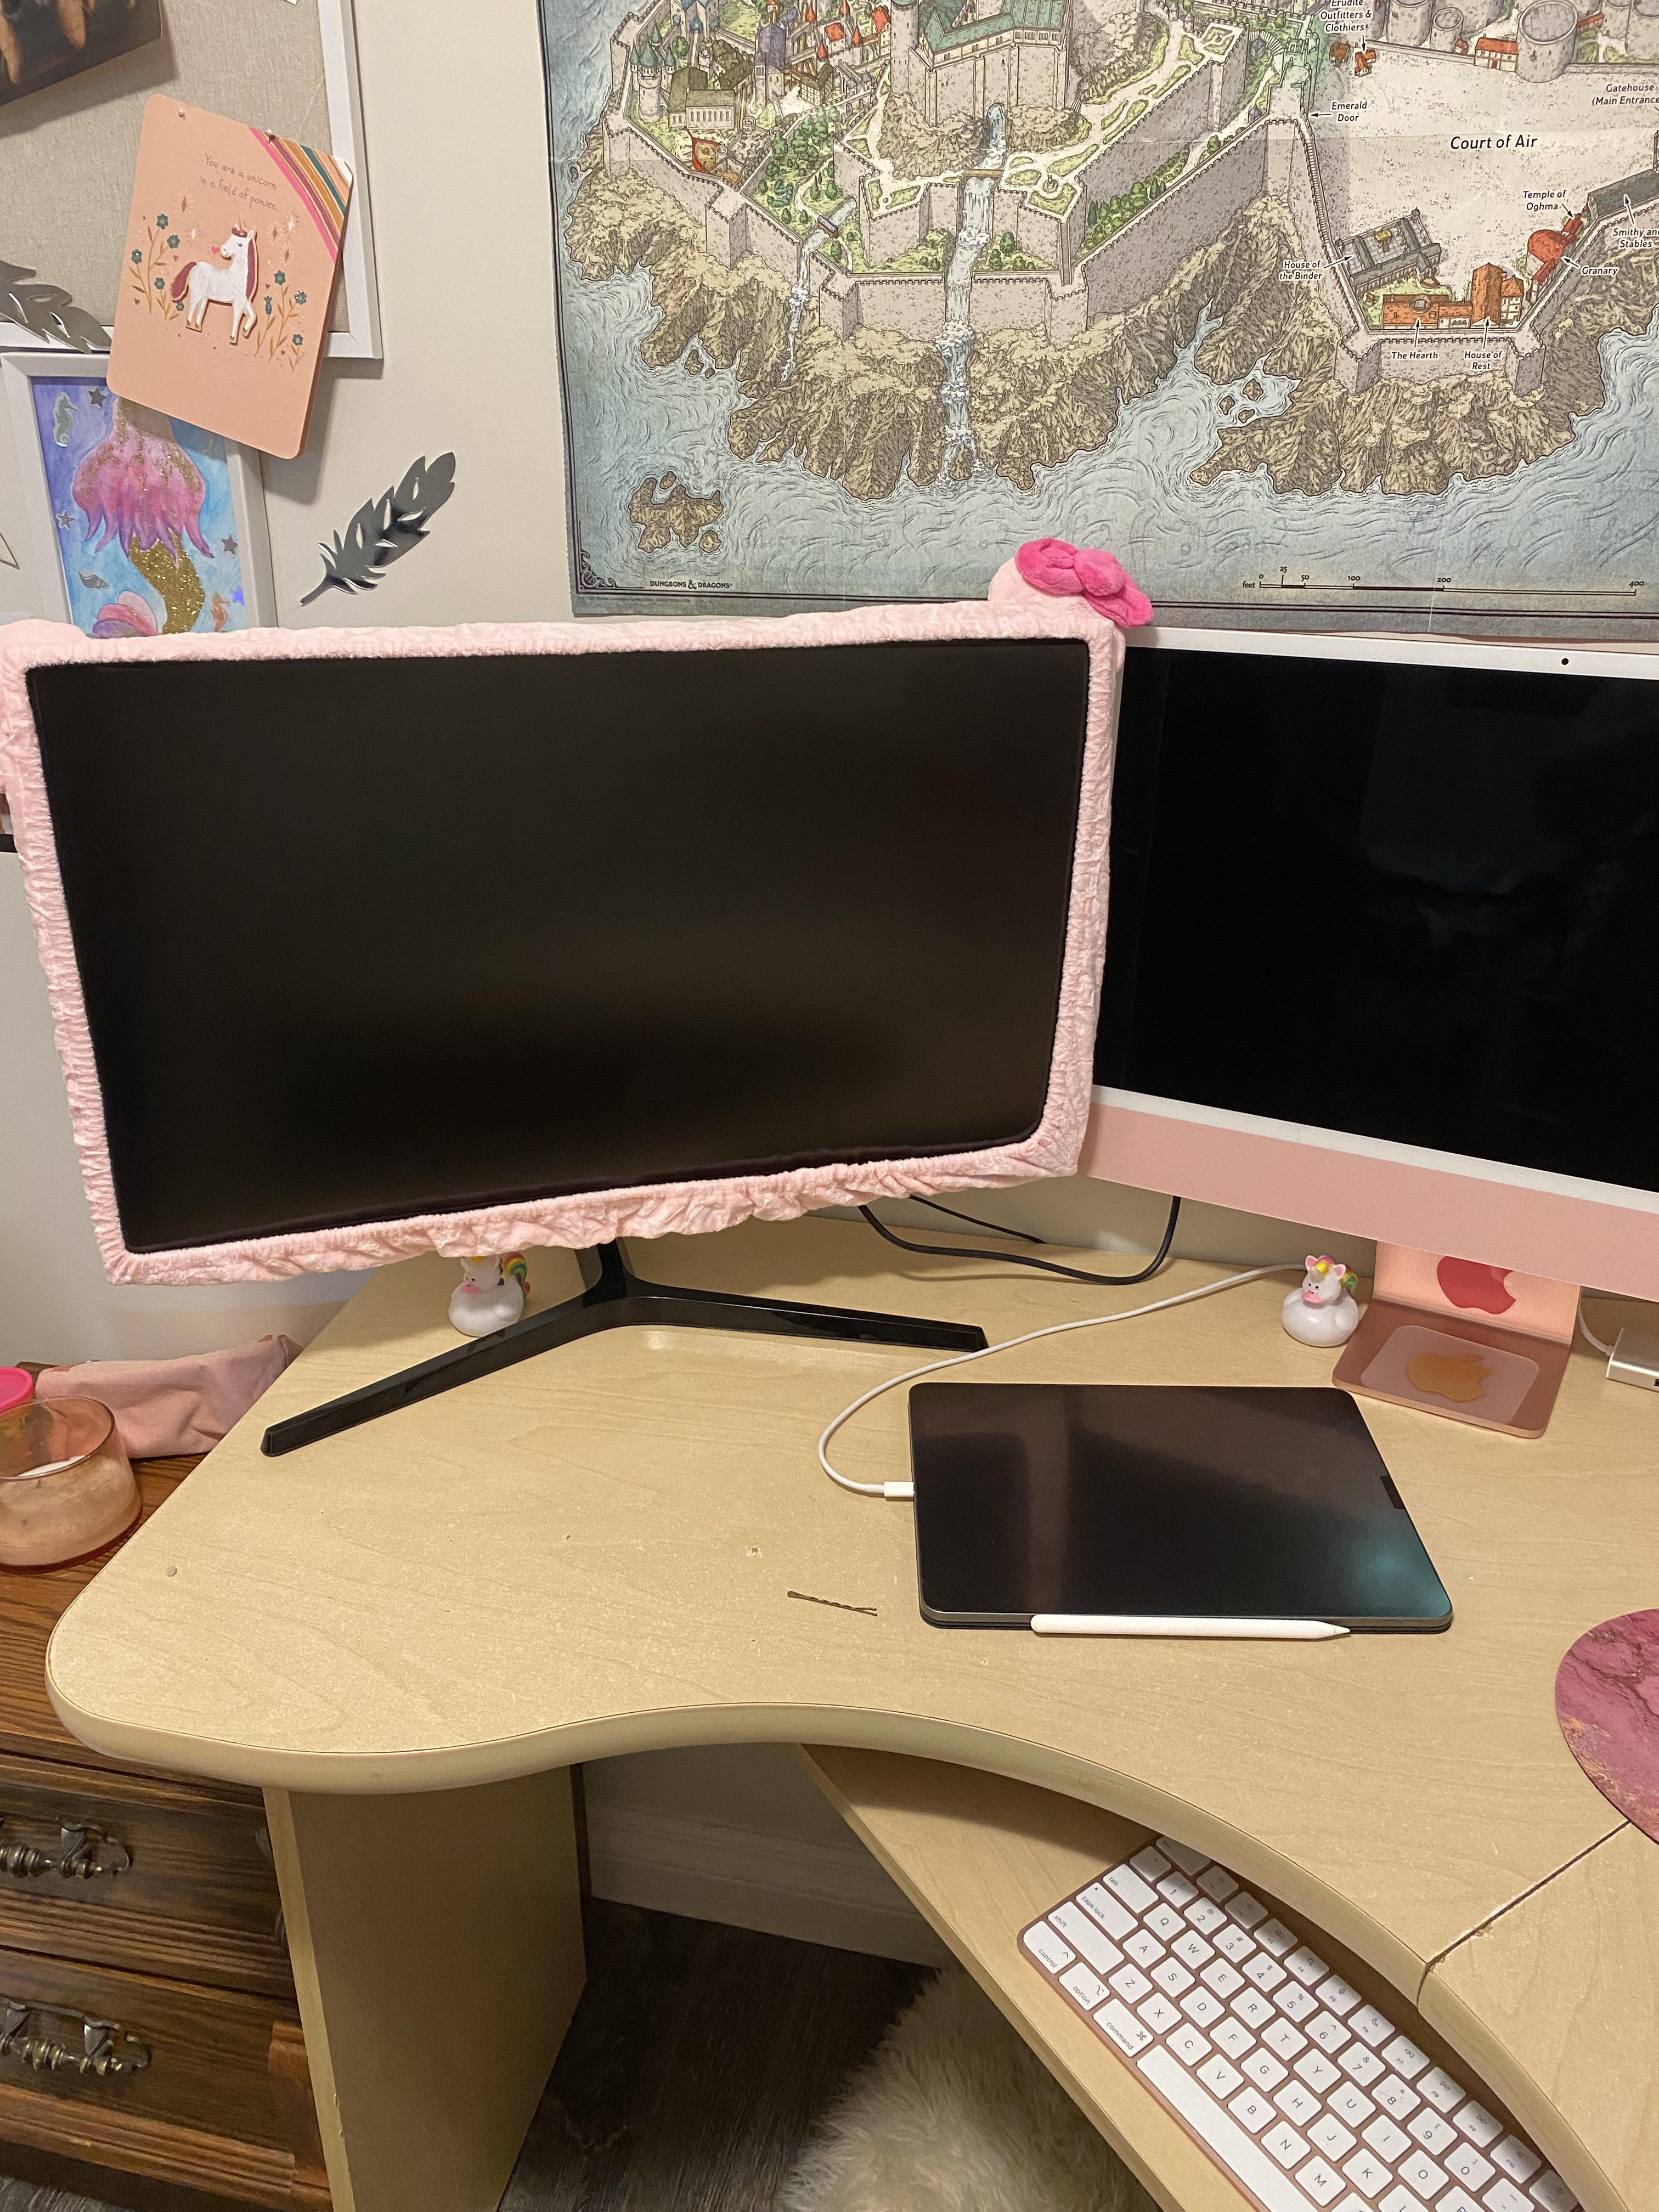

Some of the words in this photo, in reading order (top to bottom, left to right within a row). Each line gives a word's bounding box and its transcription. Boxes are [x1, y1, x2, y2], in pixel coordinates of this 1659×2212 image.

[1321, 10, 1363, 20] Outfitters
[1365, 10, 1372, 18] &
[1325, 23, 1364, 32] Clothiers
[1606, 83, 1655, 92] Gatehouse
[1331, 101, 1367, 111] Emerald
[1592, 96, 1617, 106] (Main
[1338, 113, 1359, 122] Door
[1451, 136, 1492, 150] Court
[1496, 135, 1511, 149] of
[1515, 134, 1538, 148] Air
[205, 153, 218, 168] You
[221, 165, 235, 174] are
[247, 174, 276, 190] unicorn
[199, 176, 206, 185] in
[218, 178, 236, 196] field
[239, 188, 250, 200] of
[1523, 189, 1555, 200] Temple
[1557, 189, 1567, 198] of
[1526, 202, 1558, 212] Oghma
[1613, 228, 1644, 238] Smithy
[1620, 239, 1652, 248] Stables
[1284, 260, 1310, 269] House
[1312, 260, 1321, 268] of
[1582, 266, 1618, 275] Granary
[1295, 272, 1322, 280] Binder
[1392, 351, 1407, 359] The
[1409, 351, 1438, 359] Hearth
[1464, 351, 1491, 359] House
[1493, 350, 1503, 359] of
[688, 579, 697, 590] &
[1109, 1876, 1119, 1886] tab
[1054, 1915, 1067, 1928] shift
[1160, 1917, 1169, 1927] Q
[1197, 1915, 1205, 1923] 2
[1188, 1943, 1199, 1954] W
[1038, 1949, 1058, 1968] control
[1168, 1973, 1177, 1981] S
[1217, 1974, 1227, 1982] E
[1125, 1979, 1135, 1988] Z
[1073, 1985, 1091, 2005] option
[1197, 2002, 1206, 2011] D
[1248, 2003, 1257, 2012] R
[1286, 2000, 1296, 2008] 5
[1154, 2008, 1164, 2018] X
[1106, 2022, 1135, 2050] command
[1280, 2034, 1289, 2042] T
[1319, 2032, 1328, 2040] 6
[1184, 2040, 1194, 2049] C
[1260, 2065, 1269, 2074] G
[1313, 2066, 1323, 2074] Y
[1216, 2070, 1226, 2080] V
[1291, 2097, 1303, 2108] H
[1346, 2098, 1357, 2109] U
[1387, 2096, 1397, 2106] 8
[1246, 2104, 1257, 2114] B
[1423, 2131, 1432, 2140] 9
[1280, 2139, 1291, 2150] N
[1362, 2168, 1373, 2179] K
[1314, 2174, 1327, 2187] M
